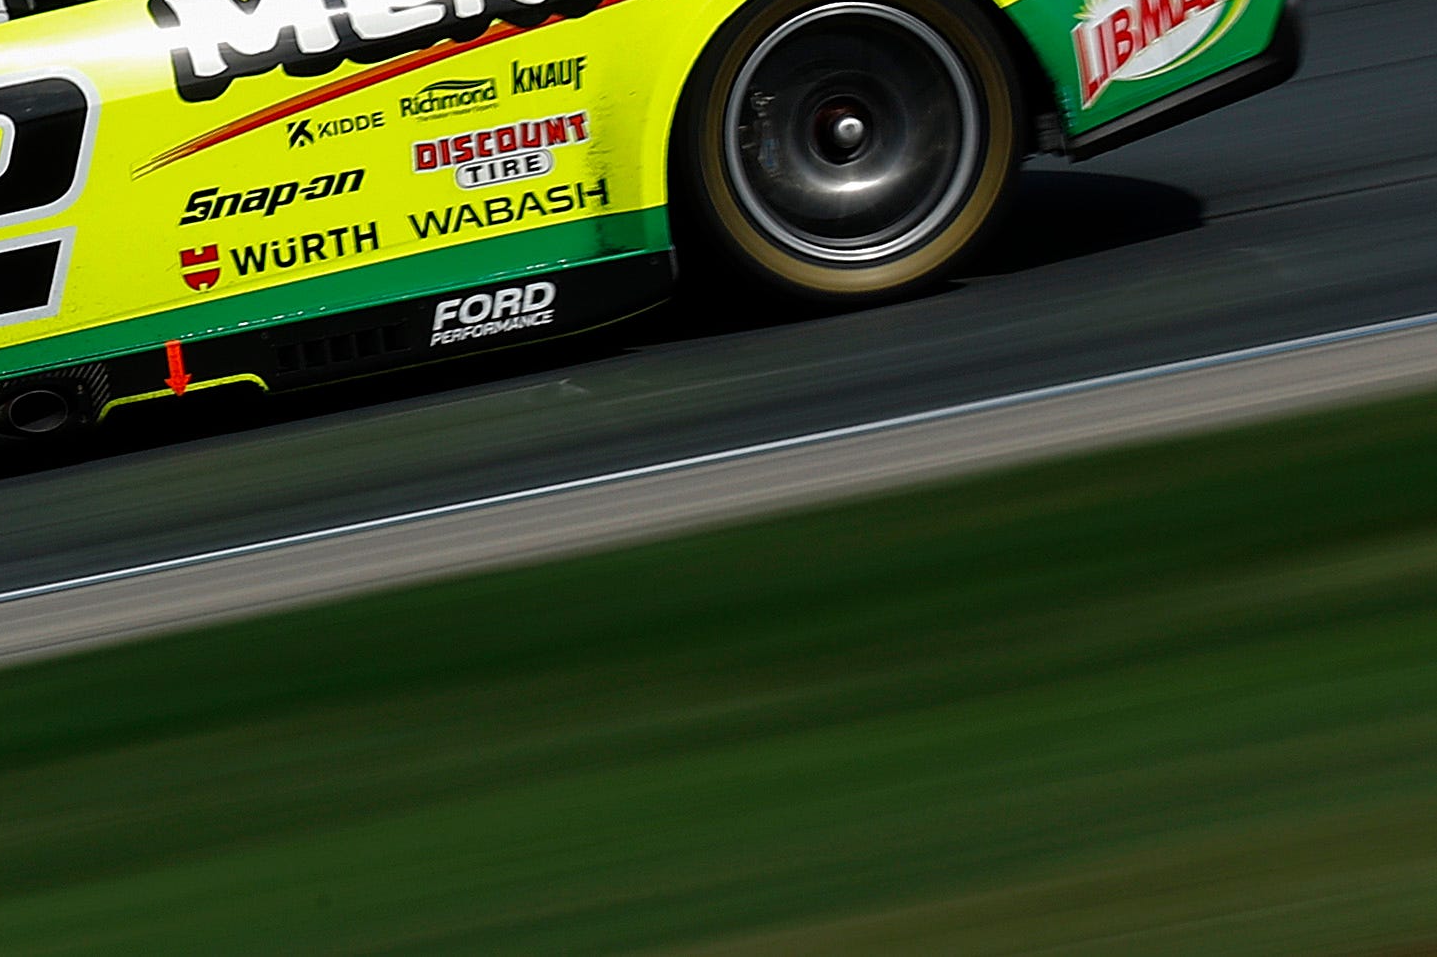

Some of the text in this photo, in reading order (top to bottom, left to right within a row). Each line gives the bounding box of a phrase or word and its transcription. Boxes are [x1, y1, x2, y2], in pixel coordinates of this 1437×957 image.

[512, 56, 588, 95] KNAUF
[400, 86, 497, 117] Richmond
[317, 111, 386, 139] KIDDE
[414, 112, 590, 172] DISCOUNT
[465, 153, 542, 183] TIRE
[177, 167, 366, 227] Snap-on
[408, 178, 610, 240] WABASH
[230, 221, 380, 276] WÜRTH
[430, 309, 555, 347] PERFORMANCE
[432, 281, 557, 331] FORD
